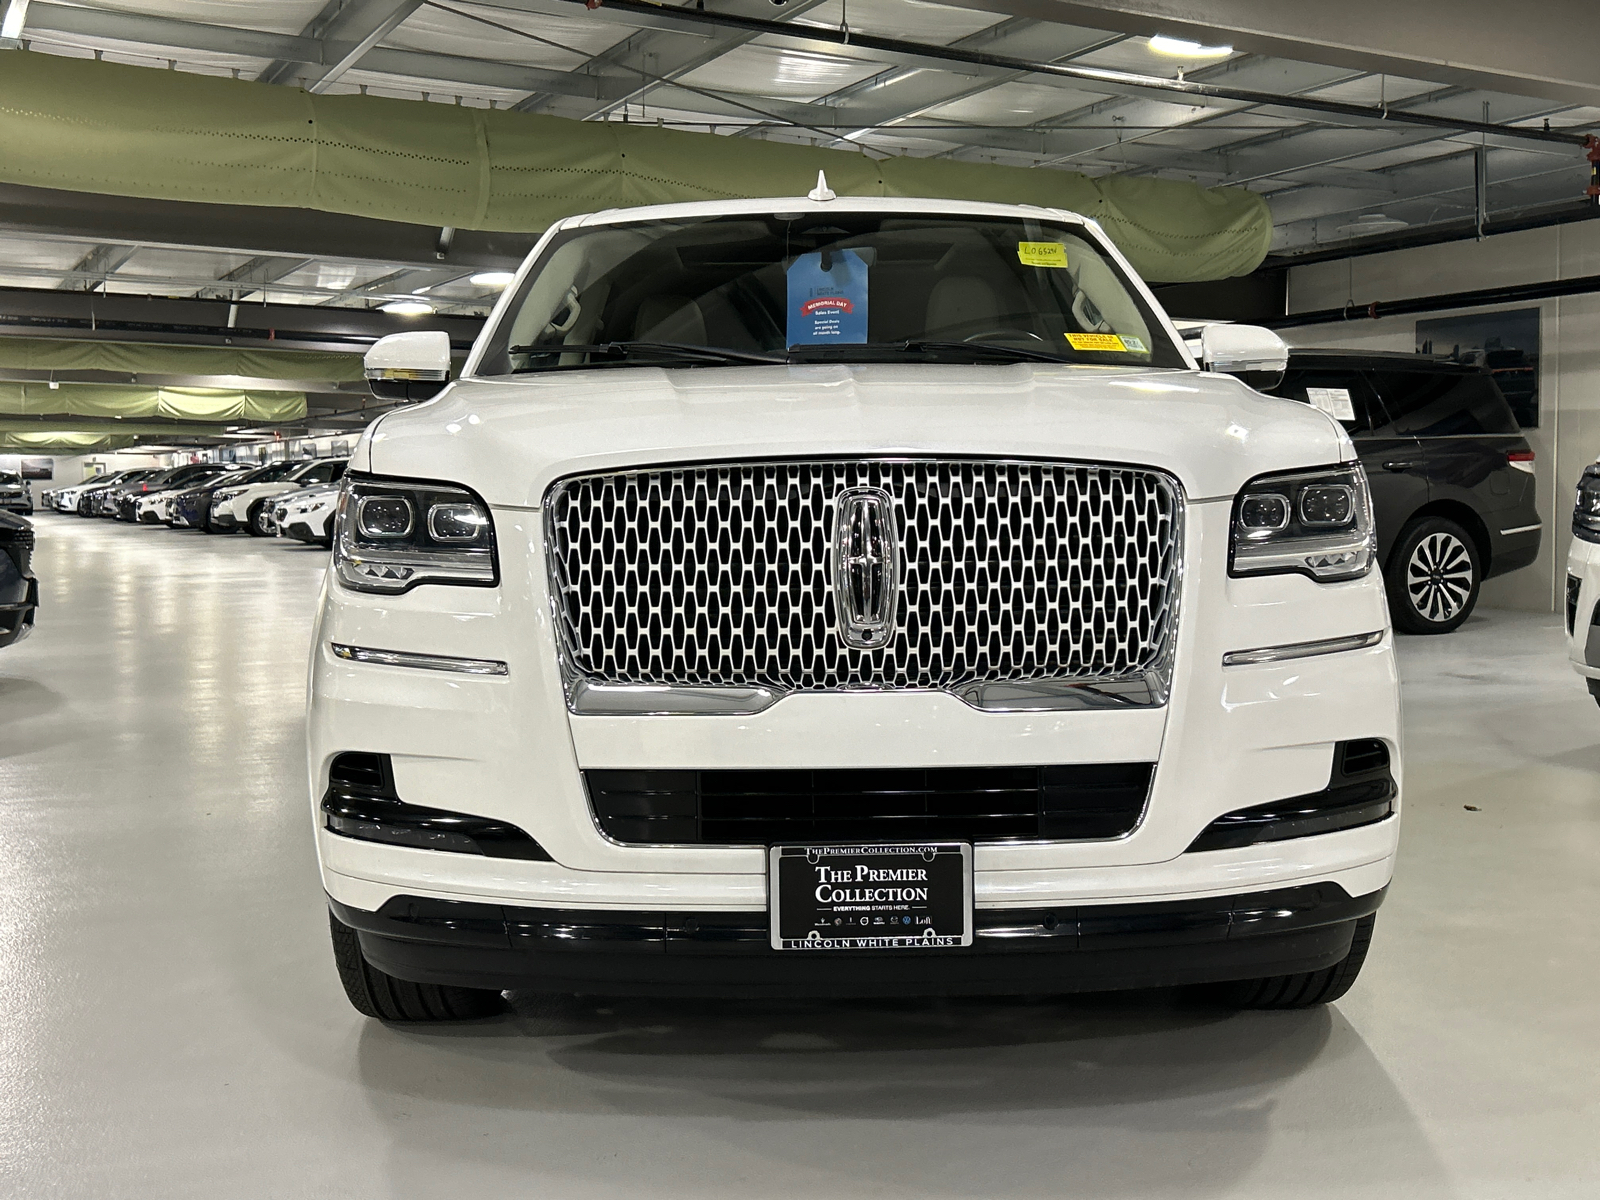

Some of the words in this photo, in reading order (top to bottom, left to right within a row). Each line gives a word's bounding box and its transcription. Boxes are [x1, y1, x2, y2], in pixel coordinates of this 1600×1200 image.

[808, 300, 835, 310] MEMORIAL
[815, 866, 852, 883] THE
[855, 865, 928, 882] PREMIER
[815, 884, 928, 903] COLLECTION
[791, 939, 850, 948] LINCOLN
[856, 938, 899, 947] WHITE
[905, 937, 954, 946] PLAINS
